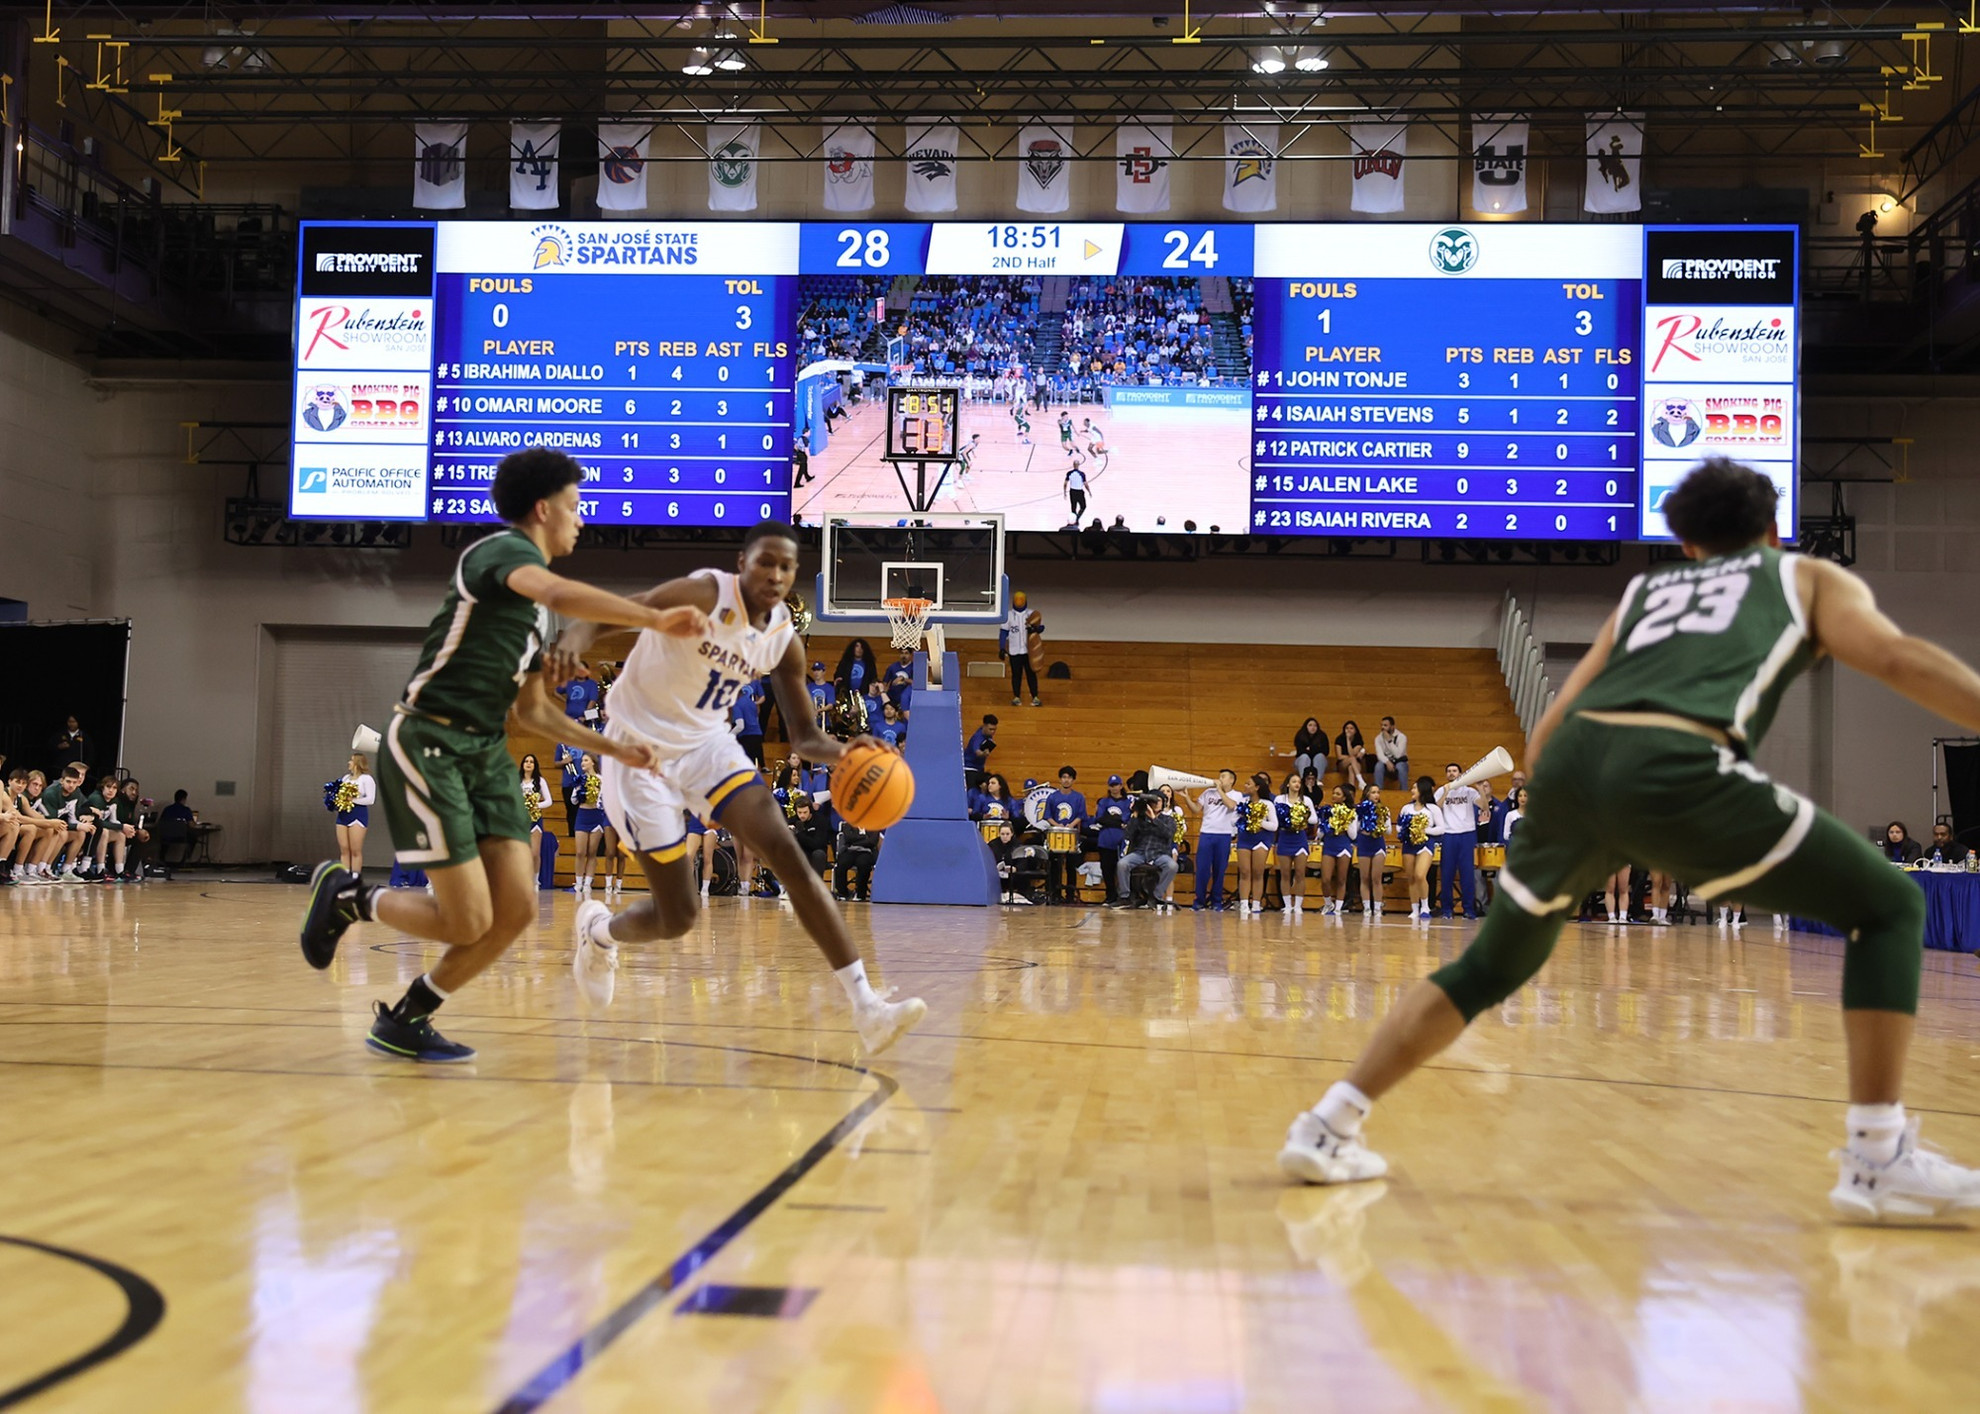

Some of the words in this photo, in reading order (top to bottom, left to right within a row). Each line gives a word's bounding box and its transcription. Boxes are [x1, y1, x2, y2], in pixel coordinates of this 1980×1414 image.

[577, 233, 608, 244] SAN
[612, 229, 650, 244] JOSÉ
[655, 233, 698, 245] STATE
[987, 225, 1061, 249] 18:51
[577, 246, 698, 265] SPARTANS
[836, 229, 890, 268] 28
[1162, 229, 1219, 269] 24
[337, 253, 417, 265] PROVIDENT
[992, 257, 1022, 269] 2ND
[1027, 256, 1056, 269] Half
[1685, 259, 1775, 271] PROVIDENT
[1685, 271, 1729, 279] CREDIT
[1735, 271, 1776, 279] UNION
[469, 278, 533, 293] FOULS
[724, 280, 763, 295] TOL
[1290, 283, 1357, 298] FOULS
[1563, 284, 1604, 299] TOL
[492, 303, 509, 328] 0
[735, 305, 752, 330] 3
[1318, 309, 1330, 333] 1
[1575, 311, 1593, 335] 3
[304, 305, 426, 361] Rubenstein
[343, 332, 427, 344] SHOWROOM
[386, 344, 401, 352] SAN
[483, 340, 555, 355] PLAYER
[615, 341, 650, 356] PTS
[659, 341, 698, 357] REB
[705, 342, 743, 357] AST
[753, 342, 788, 358] FLS
[1652, 314, 1787, 373] Rubenstein
[1694, 342, 1788, 353] SHOWROOM
[1305, 347, 1382, 362] PLAYER
[1446, 348, 1483, 363] PTS
[1494, 348, 1535, 363] REB
[1543, 349, 1583, 363] AST
[1595, 349, 1632, 364] FLS
[1742, 355, 1761, 363] SAN
[464, 364, 542, 379] IBRAHIMA
[546, 365, 604, 380] DIALLO
[628, 366, 636, 380] 1
[671, 366, 682, 380] 4
[718, 366, 728, 381] 0
[766, 367, 774, 381] 1
[1286, 372, 1340, 387] JOHN
[1343, 372, 1407, 387] TONJE
[1459, 373, 1470, 388] 3
[1510, 373, 1518, 388] 1
[1559, 374, 1567, 388] 1
[1607, 374, 1618, 389] 0
[351, 384, 398, 397] SMOKING
[403, 385, 420, 398] PIG
[351, 399, 419, 419] BBQ
[475, 398, 533, 412] OMARI
[537, 398, 603, 413] MOORE
[625, 400, 636, 415] 6
[671, 400, 682, 415] 2
[717, 400, 728, 415] 3
[765, 401, 773, 416] 1
[1706, 397, 1758, 412] SMOKING
[1763, 398, 1782, 413] PIG
[1287, 406, 1347, 421] ISAIAH
[1350, 407, 1434, 422] STEVENS
[1458, 408, 1469, 423] 5
[1509, 408, 1517, 423] 1
[1557, 409, 1568, 424] 2
[1606, 409, 1618, 424] 2
[1705, 414, 1782, 435] BBQ
[465, 431, 521, 446] ALVARO
[524, 432, 602, 447] CARDENAS
[621, 433, 639, 448] 11
[670, 434, 681, 448] 3
[718, 435, 726, 449] 1
[762, 435, 773, 450] 0
[1291, 441, 1358, 457] PATRICK
[1361, 442, 1433, 457] CARTIER
[1457, 443, 1468, 458] 9
[1507, 444, 1518, 459] 2
[1556, 444, 1567, 459] 0
[1608, 445, 1616, 460] 1
[332, 467, 376, 477] PACIFIC
[380, 468, 421, 478] OFFICE
[468, 465, 498, 480] TRE
[623, 467, 633, 482] 3
[669, 468, 680, 483] 3
[715, 468, 726, 483] 0
[763, 469, 771, 484] 1
[332, 479, 411, 488] AUTOMATION
[1297, 476, 1360, 492] JALEN
[1365, 477, 1418, 492] LAKE
[1457, 478, 1468, 493] 0
[1506, 479, 1518, 494] 3
[1556, 479, 1567, 494] 2
[1606, 480, 1617, 495] 0
[470, 499, 498, 514] SA
[622, 502, 632, 517] 5
[668, 502, 678, 517] 6
[714, 503, 725, 518] 0
[760, 503, 771, 519] 0
[1296, 511, 1358, 527] ISAIAH
[1361, 512, 1432, 528] RIVERA
[1456, 514, 1468, 529] 2
[1505, 514, 1517, 530] 2
[1555, 515, 1566, 530] 0
[1607, 516, 1615, 531] 1
[1625, 572, 1750, 652] 23
[695, 668, 740, 710] 10
